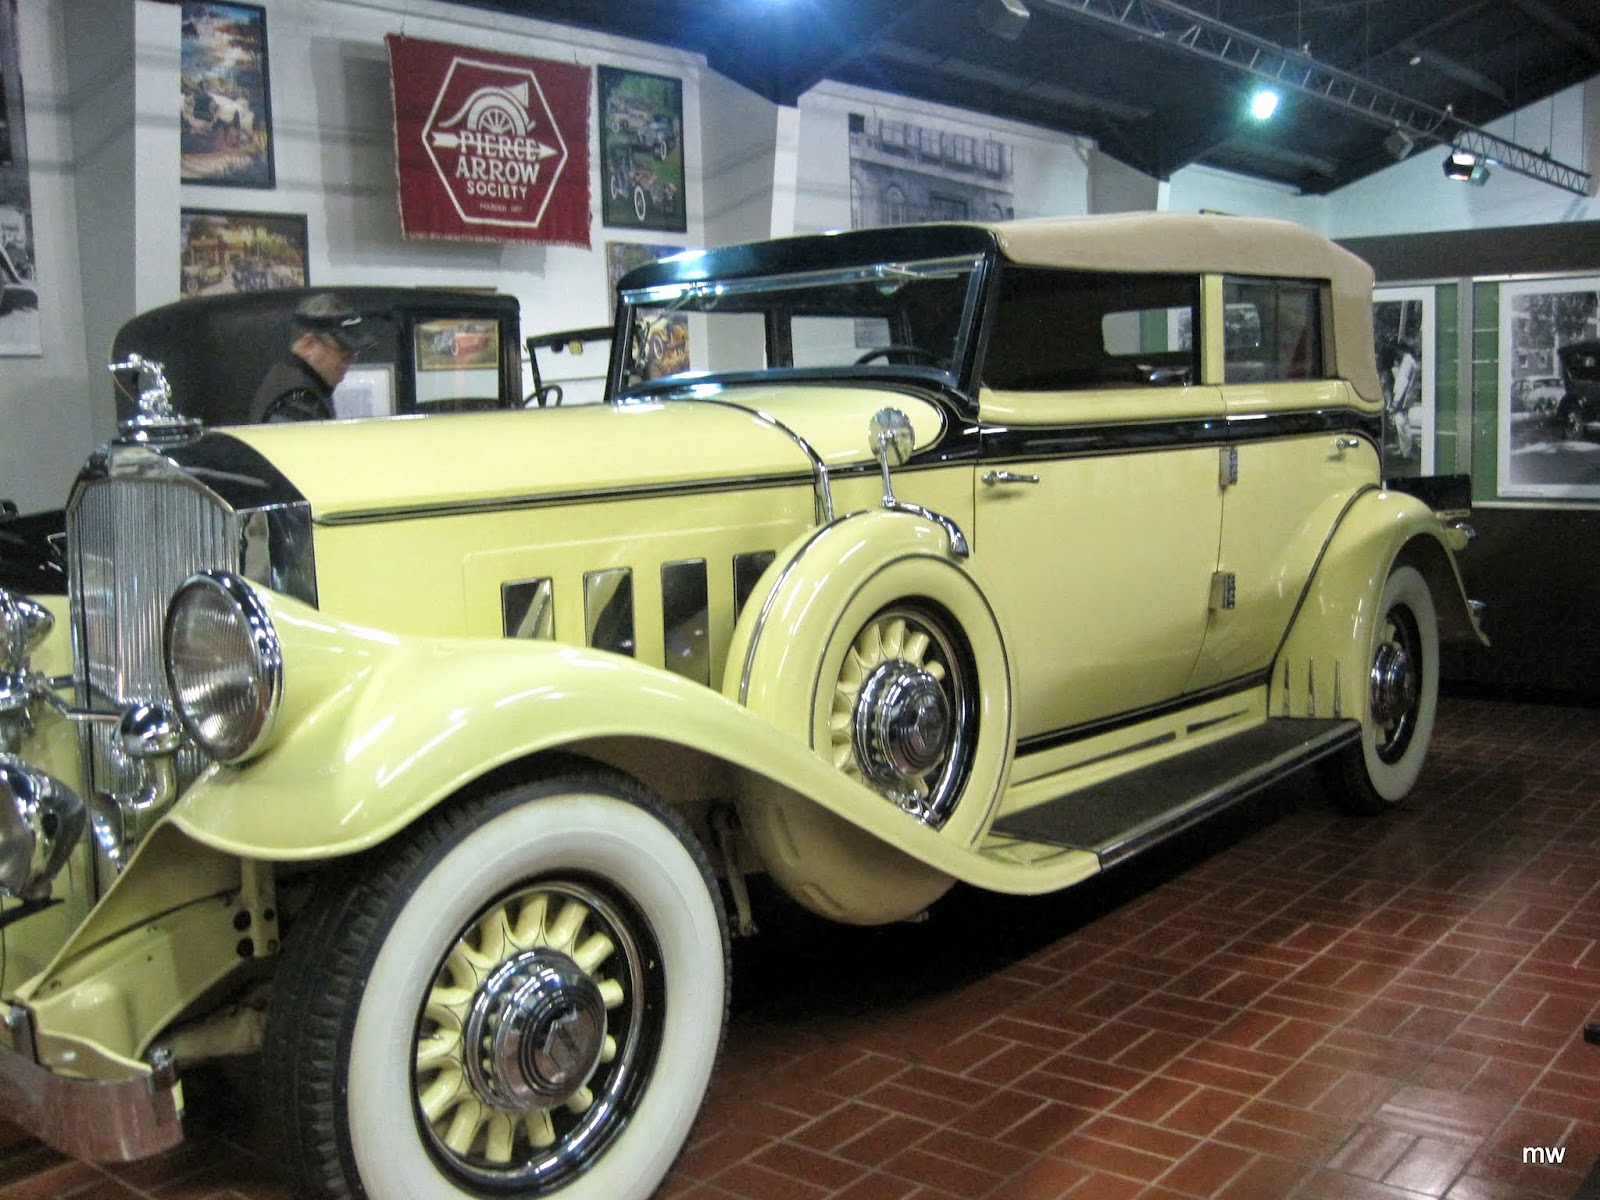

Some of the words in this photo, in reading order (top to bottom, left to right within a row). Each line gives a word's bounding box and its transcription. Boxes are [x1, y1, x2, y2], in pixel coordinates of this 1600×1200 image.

[459, 130, 537, 161] PIERCE
[455, 156, 540, 185] ARROW
[467, 180, 527, 200] SOCIETY
